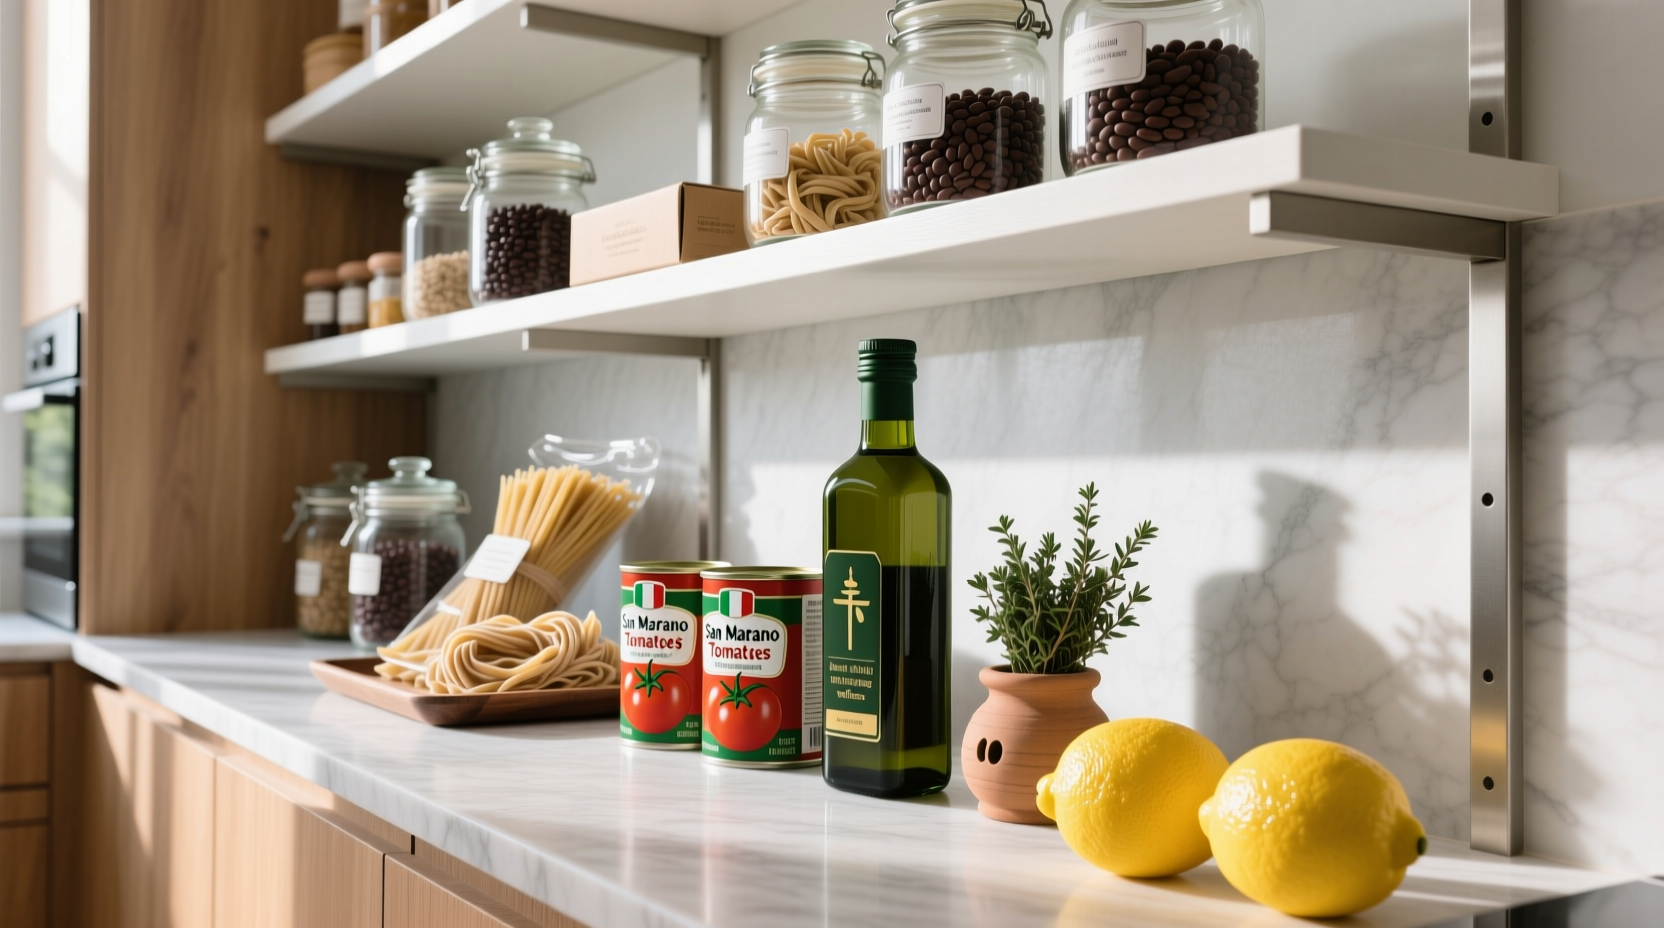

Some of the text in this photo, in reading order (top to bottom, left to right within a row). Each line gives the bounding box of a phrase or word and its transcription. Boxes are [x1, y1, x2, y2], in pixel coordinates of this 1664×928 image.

[638, 615, 689, 632] Marano
[705, 623, 780, 642] San Marano
